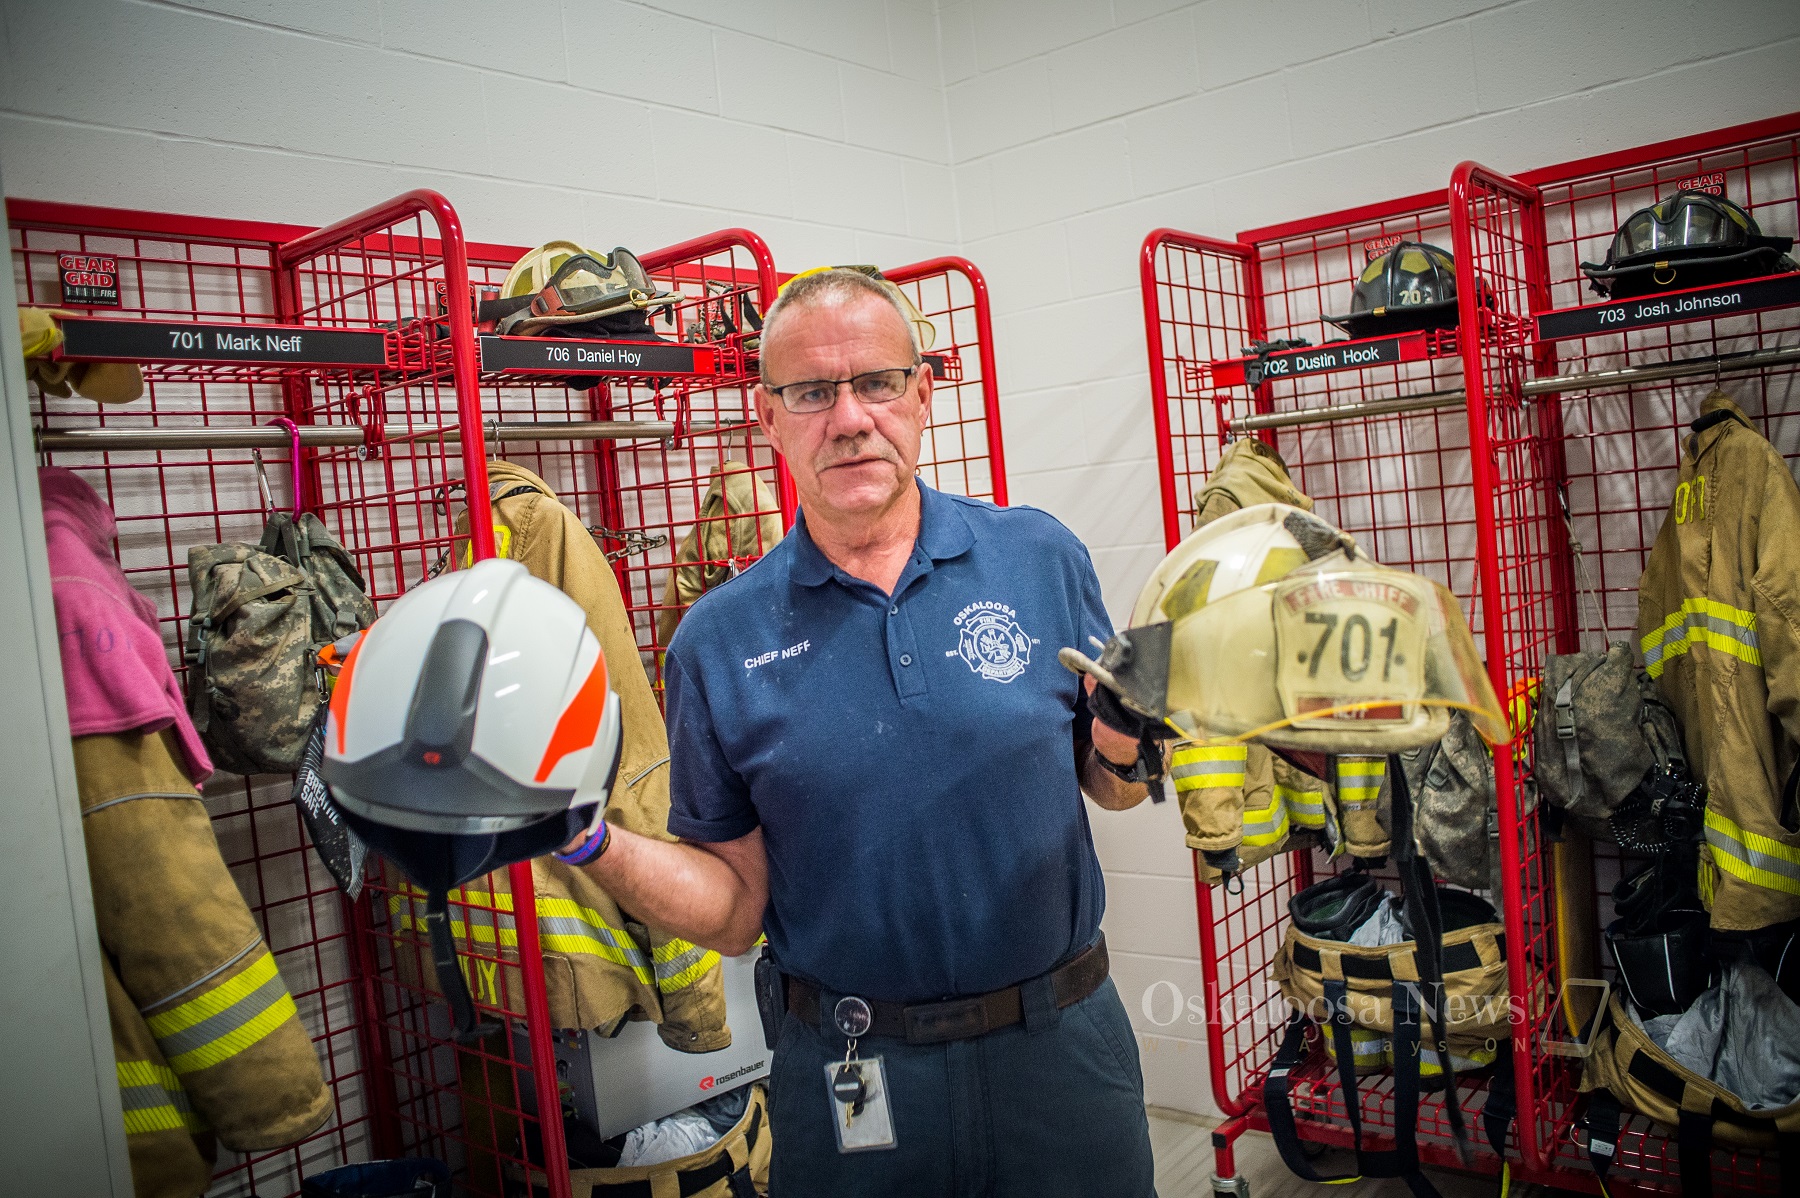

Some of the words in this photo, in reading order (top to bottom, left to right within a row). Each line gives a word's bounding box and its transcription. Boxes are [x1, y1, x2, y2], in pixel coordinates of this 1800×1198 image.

[1678, 173, 1724, 190] GEAR
[60, 255, 116, 273] GEAR
[65, 271, 113, 287] GRID
[100, 289, 117, 298] FIRE
[1598, 308, 1626, 324] 703
[1634, 301, 1670, 319] Josh
[1674, 293, 1741, 312] Johnson
[169, 331, 203, 349] 701
[216, 333, 261, 351] Mark
[266, 335, 302, 352] Neff
[546, 347, 570, 361] 706
[577, 348, 615, 363] Daniel
[618, 349, 641, 366] Hoy
[1264, 360, 1289, 376] 702
[1296, 353, 1336, 371] Dustin
[1343, 346, 1380, 364] Hook
[1351, 583, 1410, 607] CHIEF
[953, 601, 1016, 626] OSKALOOSA
[744, 650, 779, 669] CHIEF
[781, 639, 811, 659] NEFF
[1304, 611, 1398, 683] 701
[300, 784, 320, 819] SAFE
[456, 953, 498, 1005] OY
[715, 1060, 765, 1086] rosenbauer
